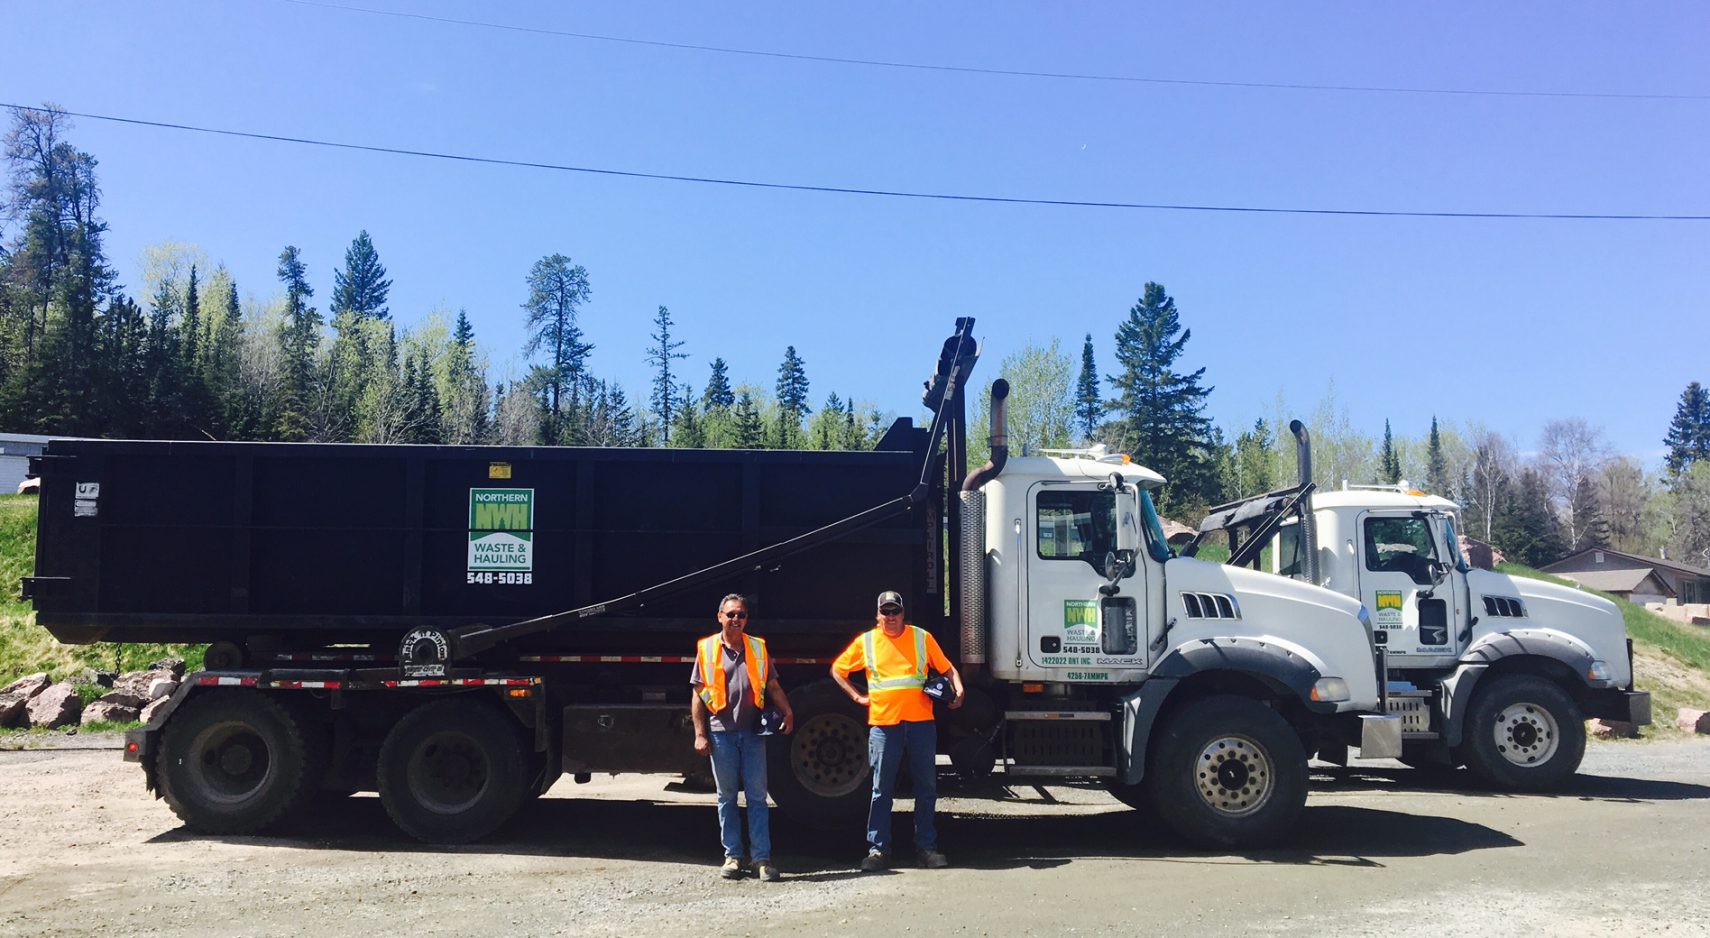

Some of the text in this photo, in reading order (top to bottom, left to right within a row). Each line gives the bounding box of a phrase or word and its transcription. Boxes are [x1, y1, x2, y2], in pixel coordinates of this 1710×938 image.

[475, 493, 528, 502] NORTHERN
[475, 503, 528, 530] NWH
[474, 543, 527, 553] WASTE &
[473, 554, 526, 564] HAULING
[467, 572, 532, 585] 548-5038
[1066, 607, 1096, 623] NWH
[1063, 646, 1100, 654] 548-5038
[1041, 657, 1067, 665] 1422022
